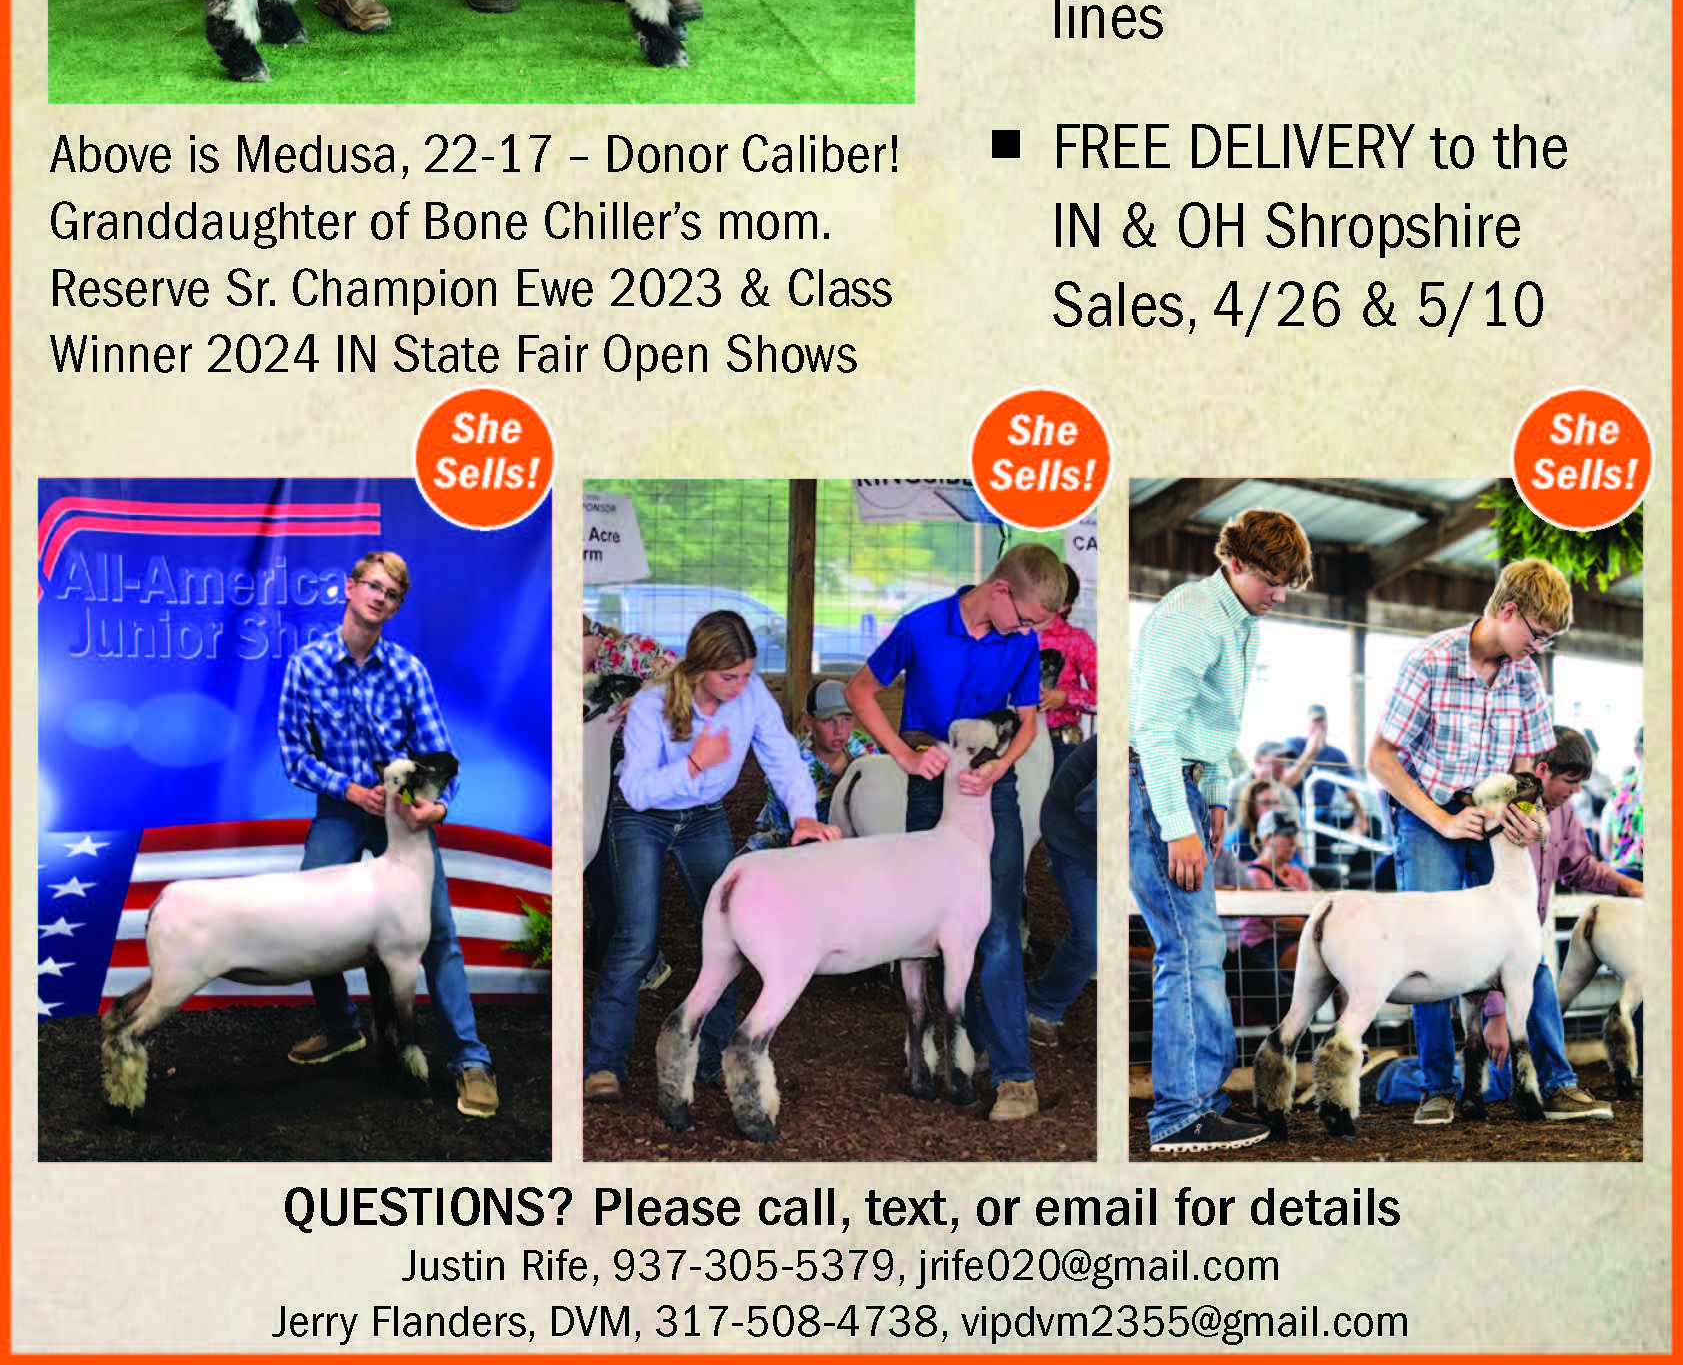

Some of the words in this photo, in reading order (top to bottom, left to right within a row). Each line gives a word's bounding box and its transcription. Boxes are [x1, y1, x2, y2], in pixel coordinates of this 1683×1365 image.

[50, 135, 171, 173] Above
[190, 135, 219, 173] is
[238, 135, 408, 179] Medusa,
[425, 134, 551, 172] 22-17
[608, 135, 728, 173] Donor
[743, 134, 897, 173] Caliber!
[1057, 124, 1170, 168] FREE
[1192, 124, 1415, 168] DELIVERY
[1430, 128, 1474, 169] to
[1493, 124, 1567, 169] the
[51, 201, 356, 249] Granddaughter
[371, 201, 410, 240] of
[426, 202, 527, 240] Bone
[545, 201, 701, 240] Chiller’s
[720, 211, 829, 240] mom.
[1056, 203, 1099, 247] IN
[1123, 202, 1156, 248] &
[1179, 202, 1243, 248] OH
[1266, 202, 1520, 258] Shropshire
[53, 269, 209, 307] Reserve
[227, 268, 275, 306] Sr.
[293, 268, 496, 315] Champion
[518, 269, 593, 307] Ewe
[611, 268, 721, 307] 2023
[741, 268, 770, 307] &
[789, 268, 892, 307] Class
[1053, 281, 1195, 334] Sales,
[1214, 281, 1340, 337] 4/26
[1363, 281, 1396, 327] &
[1419, 281, 1543, 337] 5/10
[50, 335, 192, 373] Winner
[208, 334, 319, 373] 2024
[338, 335, 375, 372] IN
[394, 334, 499, 373] State
[519, 335, 588, 373] Fair
[604, 334, 707, 381] Open
[727, 334, 857, 373] Shows
[452, 413, 521, 443] She
[1008, 415, 1077, 445] She
[1550, 413, 1619, 444] She
[434, 457, 539, 488] Sells!
[990, 459, 1095, 490] Sells!
[1532, 459, 1638, 489] Sells!
[589, 526, 621, 543] Acre
[70, 605, 224, 659] Junior
[285, 1187, 572, 1233] QUESTIONS?
[596, 1188, 740, 1226] Please
[759, 1188, 849, 1233] call,
[865, 1190, 958, 1233] text,
[977, 1197, 1020, 1226] or
[1036, 1188, 1156, 1226] email
[1175, 1187, 1235, 1226] for
[1251, 1188, 1400, 1226] details
[402, 1250, 504, 1281] Justin
[524, 1249, 598, 1286] Rife,
[614, 1249, 904, 1286] 937-305-5379,
[916, 1249, 1278, 1289] jrife020@gmail.com
[272, 1306, 358, 1345] Jerry
[374, 1306, 534, 1342] Flanders,
[552, 1306, 640, 1342] DVM,
[656, 1305, 947, 1342] 317-508-4738,
[961, 1305, 1407, 1345] vipdvm2355@gmail.com
